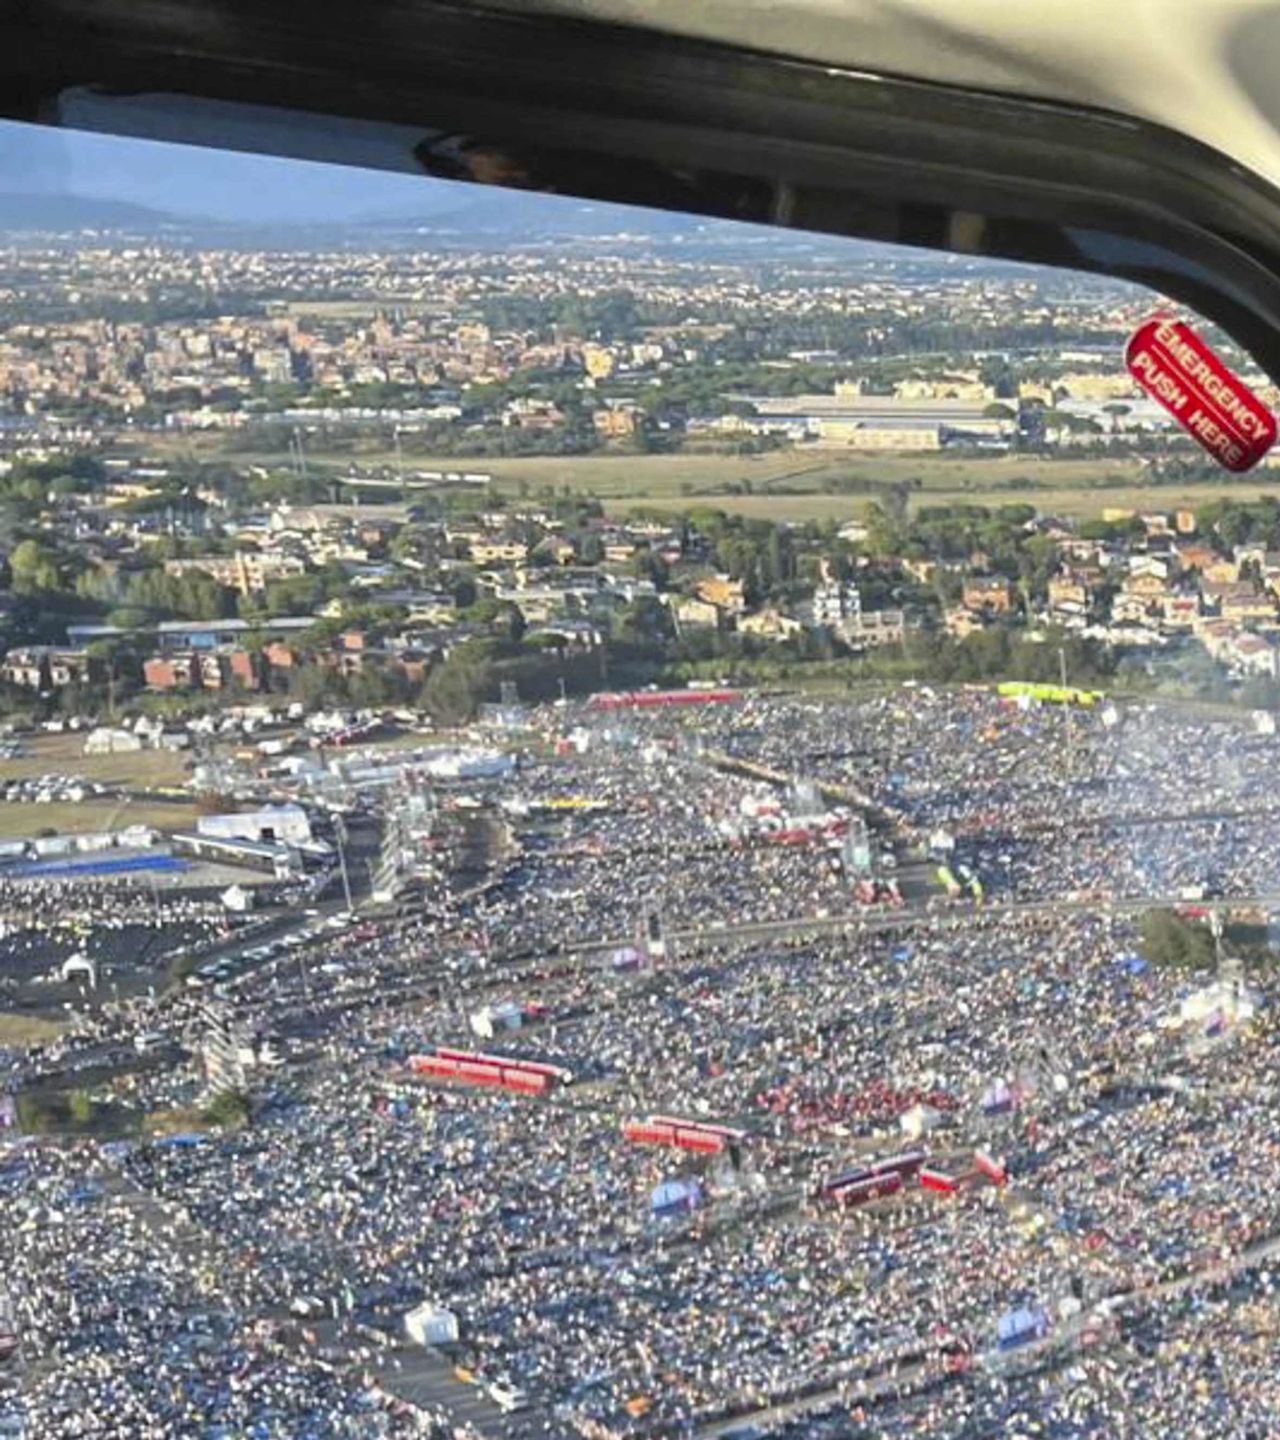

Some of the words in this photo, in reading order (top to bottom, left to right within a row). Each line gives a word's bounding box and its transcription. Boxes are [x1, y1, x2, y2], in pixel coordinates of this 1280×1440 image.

[1132, 351, 1188, 409] PUSH
[1188, 410, 1243, 463] HERE
[1154, 319, 1269, 439] EMERGENCY
